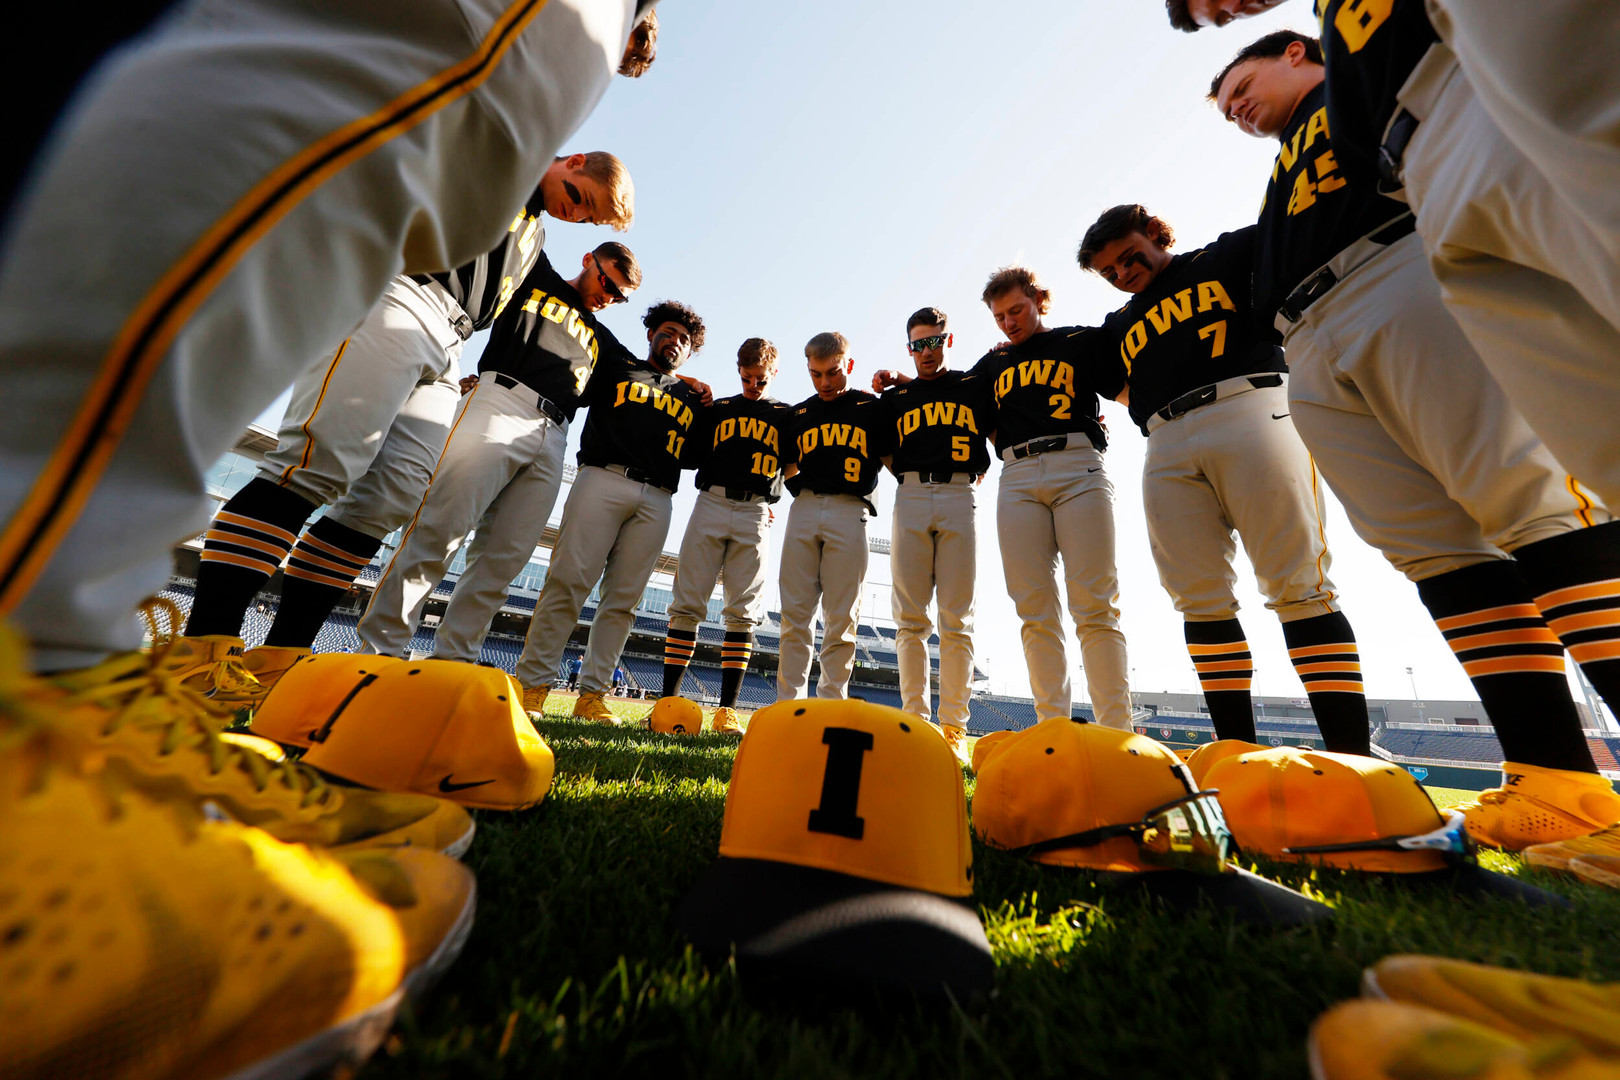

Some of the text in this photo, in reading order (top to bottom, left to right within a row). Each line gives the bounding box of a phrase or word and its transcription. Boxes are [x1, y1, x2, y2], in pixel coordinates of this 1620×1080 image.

[521, 288, 599, 375] IOWA
[1120, 280, 1236, 377] IOWA
[1197, 319, 1228, 359] 7
[994, 360, 1075, 409] IOWA
[613, 381, 694, 433] IOWA
[897, 401, 979, 449] IOWA
[1048, 394, 1072, 420] 2
[665, 430, 686, 460] 11
[713, 417, 779, 457] IOWA
[797, 423, 869, 464] IOWA
[951, 436, 971, 462] 5
[751, 452, 778, 479] 10
[844, 457, 862, 483] 9
[807, 727, 874, 840] I
